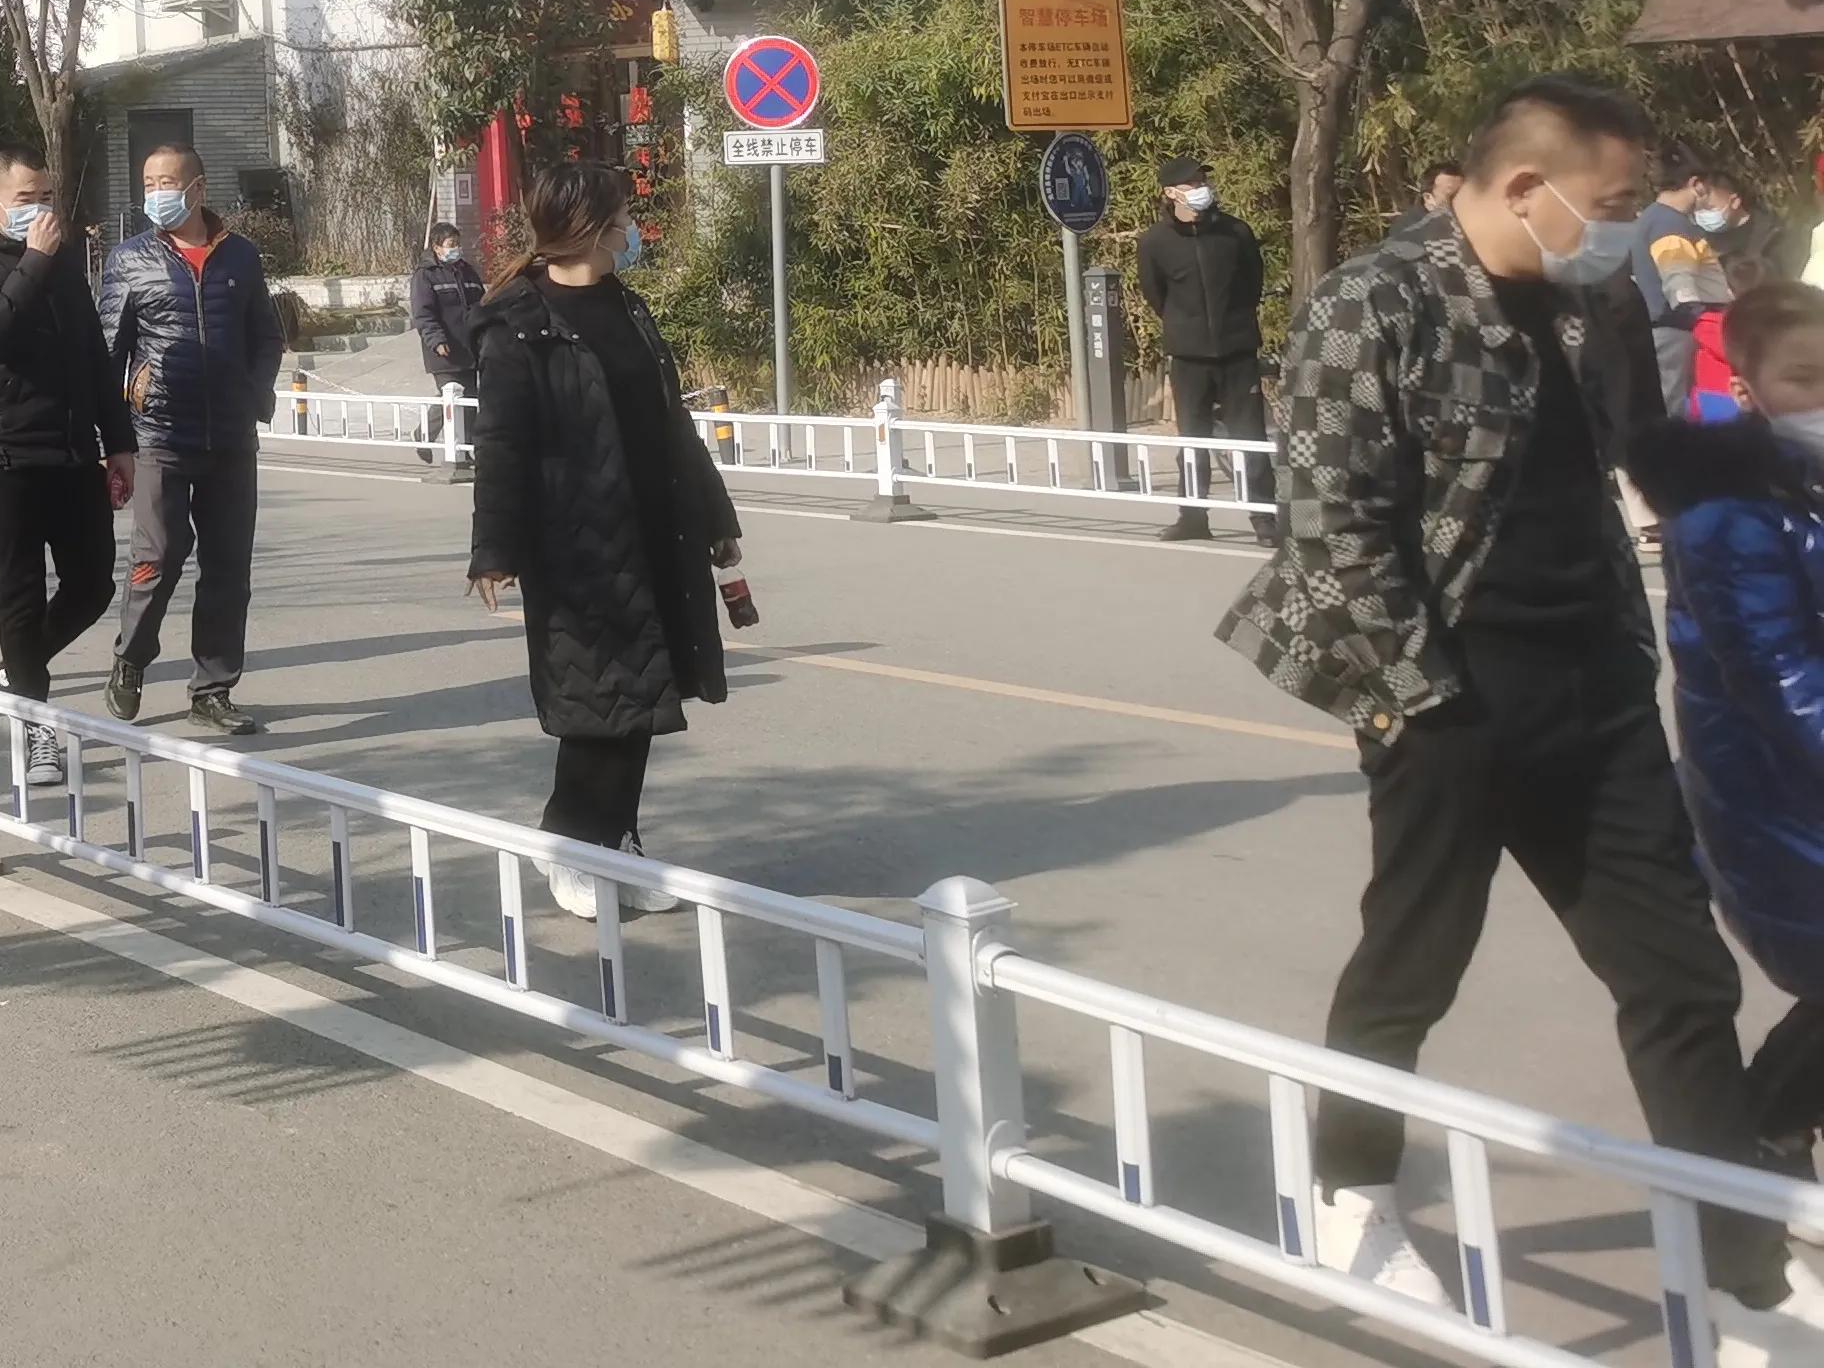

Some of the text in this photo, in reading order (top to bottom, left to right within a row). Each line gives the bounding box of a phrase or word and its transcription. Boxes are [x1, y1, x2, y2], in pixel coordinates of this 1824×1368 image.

[1019, 8, 1109, 27] 智慧停车场
[732, 136, 817, 158] 全线禁止停车
